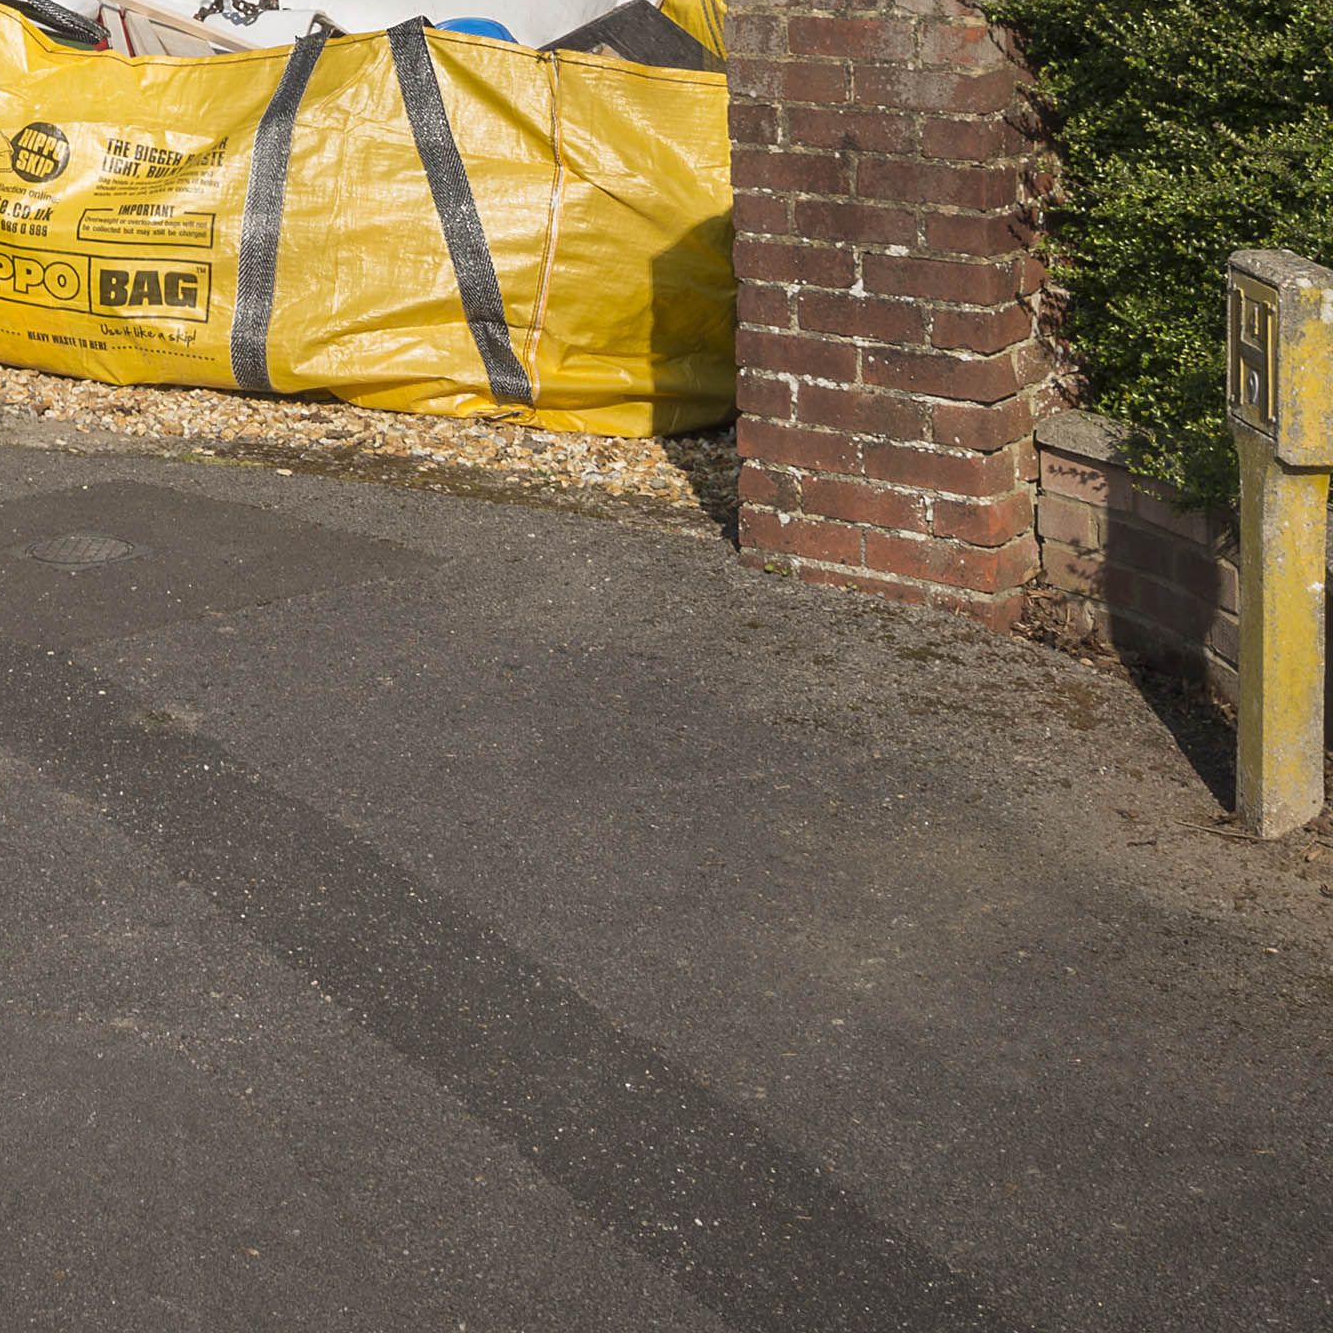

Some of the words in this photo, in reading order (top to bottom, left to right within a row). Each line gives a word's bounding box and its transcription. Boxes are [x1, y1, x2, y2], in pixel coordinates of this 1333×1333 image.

[17, 128, 68, 161] HIPPO
[107, 137, 132, 158] THE
[134, 144, 183, 167] BIGGER
[16, 149, 55, 178] SKIP
[101, 156, 141, 179] LIGHT,
[117, 203, 175, 218] IMPORTANT
[99, 268, 199, 309] BAG
[27, 330, 50, 343] HEAVY
[51, 334, 78, 346] WASTE
[78, 337, 87, 349] TO
[88, 339, 108, 351] HERE
